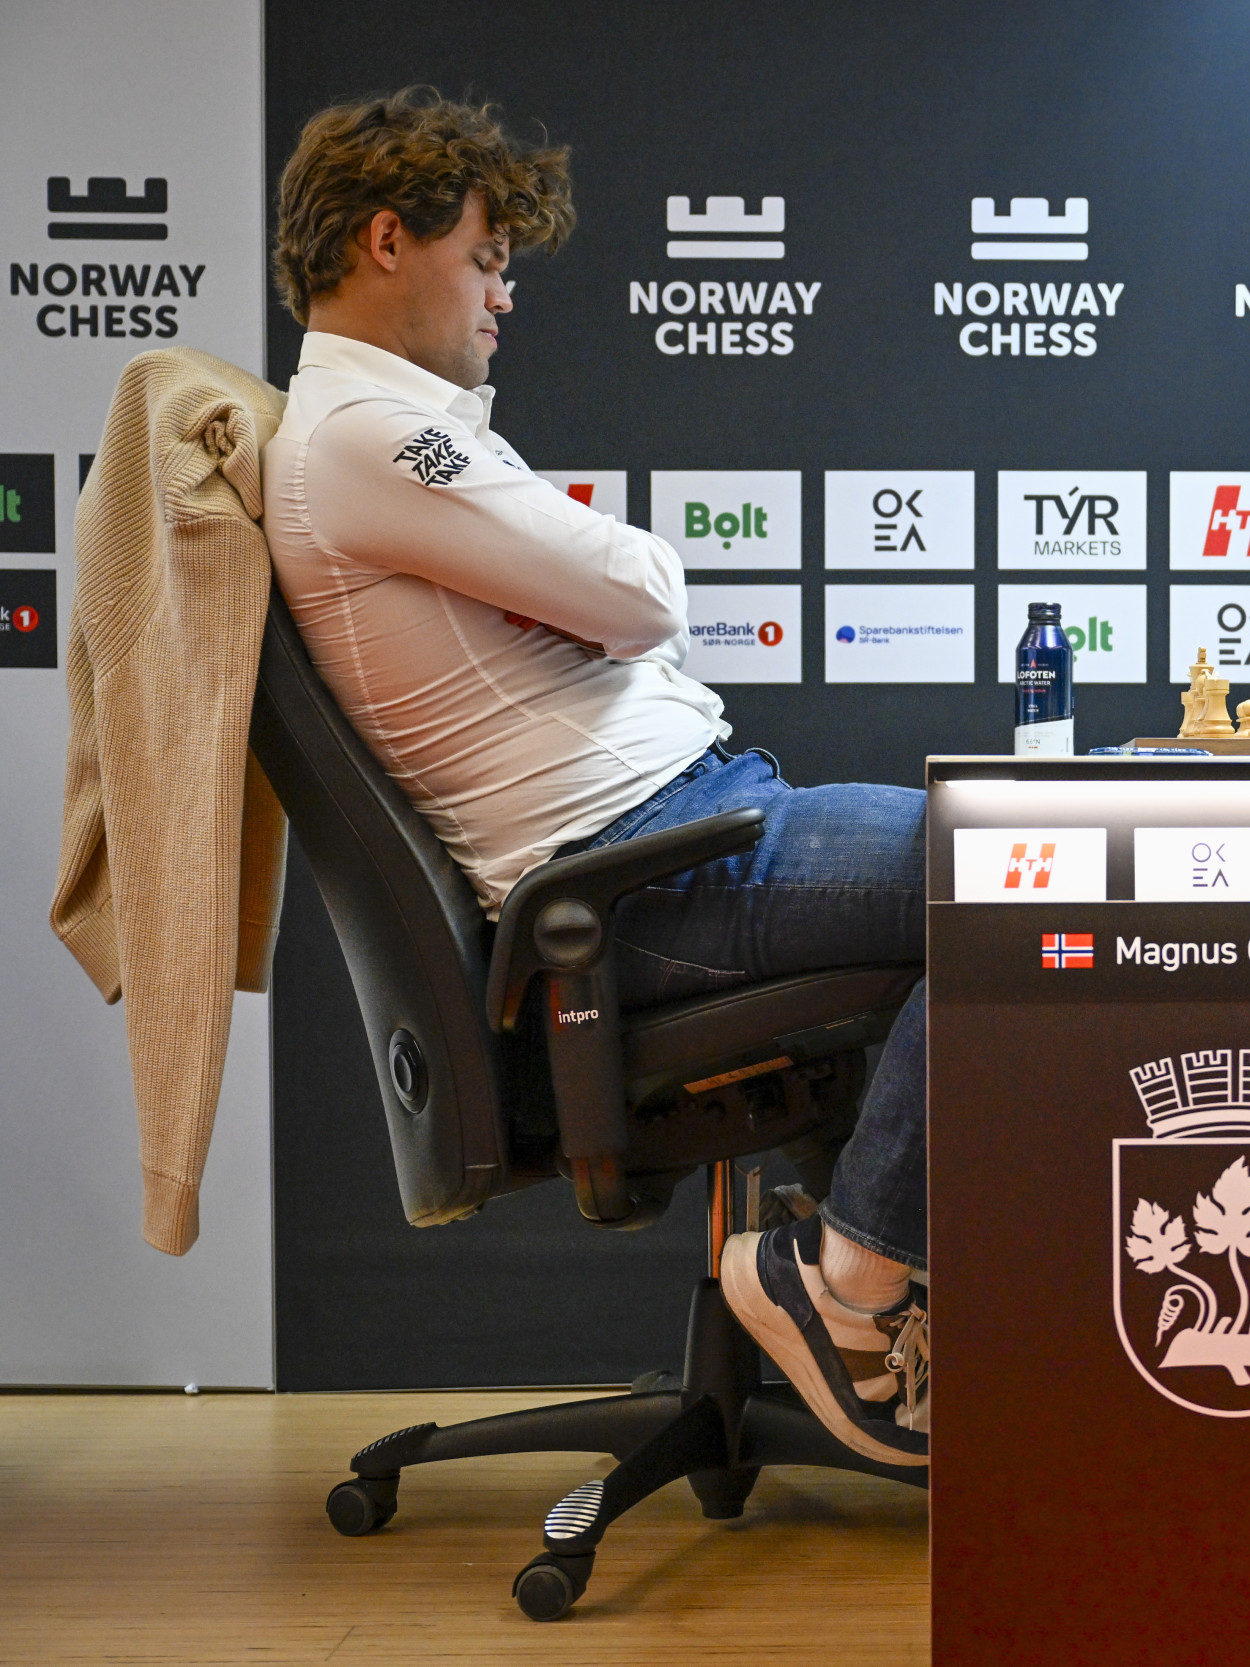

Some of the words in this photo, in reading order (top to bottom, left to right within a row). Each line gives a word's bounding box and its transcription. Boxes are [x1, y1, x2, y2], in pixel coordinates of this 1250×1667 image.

[10, 263, 205, 297] NORWAY
[630, 281, 821, 314] NORWAY
[935, 282, 1124, 316] NORWAY
[36, 304, 178, 338] CHESS
[656, 322, 794, 355] CHESS
[960, 322, 1097, 356] CHESS
[393, 427, 448, 463] TAKE
[412, 438, 456, 482] TAKE
[425, 452, 472, 486] TAKE
[873, 489, 922, 518] OK
[1024, 486, 1119, 535] TÝR
[685, 502, 767, 550] Bolt
[1035, 541, 1121, 555] MARKETS
[859, 626, 963, 636] Sparebankstiftelsen
[1068, 616, 1113, 663] olt
[1017, 671, 1055, 679] LOFOTEN
[1192, 843, 1225, 862] OK
[1117, 937, 1237, 971] Magnus
[558, 1010, 598, 1024] intpro
